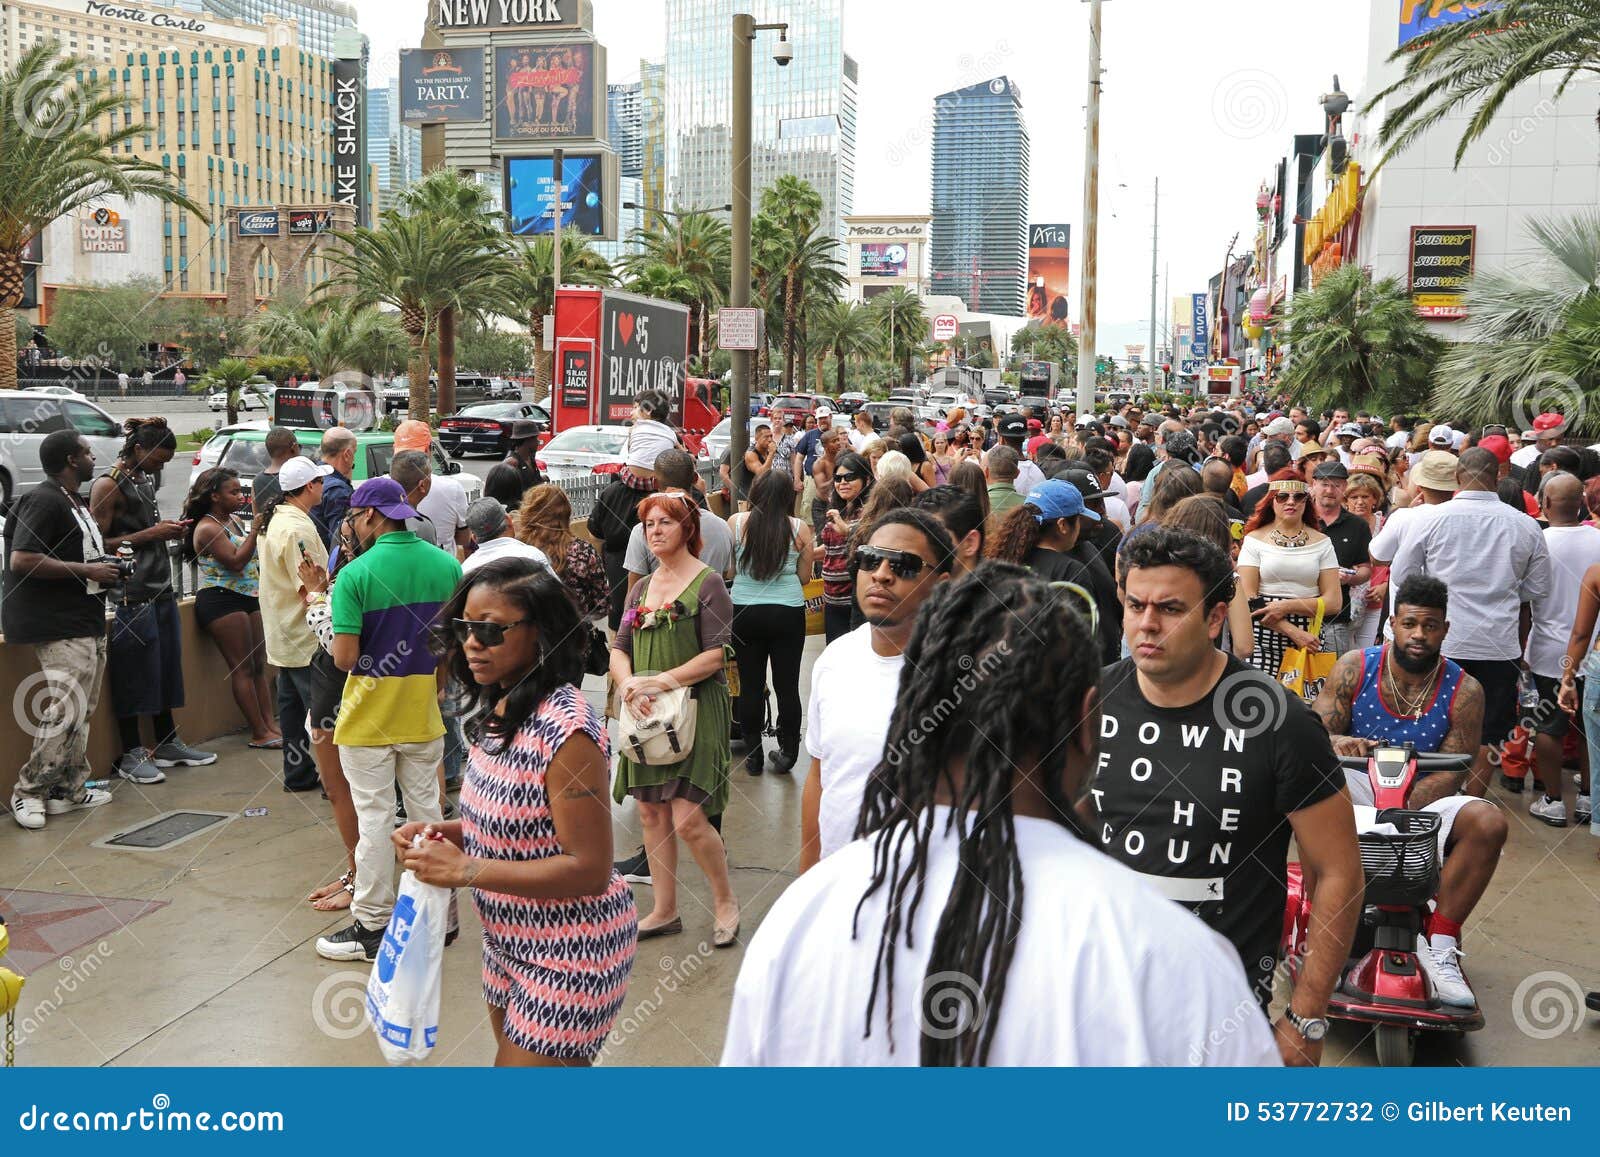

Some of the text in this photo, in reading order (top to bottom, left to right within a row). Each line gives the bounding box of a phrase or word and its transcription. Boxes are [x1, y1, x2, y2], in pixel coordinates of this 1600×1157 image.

[86, 1, 206, 32] Monte Carlo
[438, 0, 562, 26] NEW YORK
[417, 85, 470, 101] PARTY.
[337, 77, 356, 155] SHACK
[338, 165, 356, 206] AKE
[82, 223, 124, 239] toms
[849, 225, 922, 235] Monte Carlo
[1033, 226, 1066, 245] Aria
[83, 239, 125, 251] urban
[1415, 235, 1472, 245] SUBWAY
[1414, 256, 1470, 266] SUBWAY
[937, 319, 954, 327] CVS
[1196, 296, 1205, 335] ROSS
[636, 315, 649, 354] $5
[565, 377, 587, 387] JACK
[609, 356, 680, 398] BLACK JACK
[1100, 714, 1246, 753] DOWN
